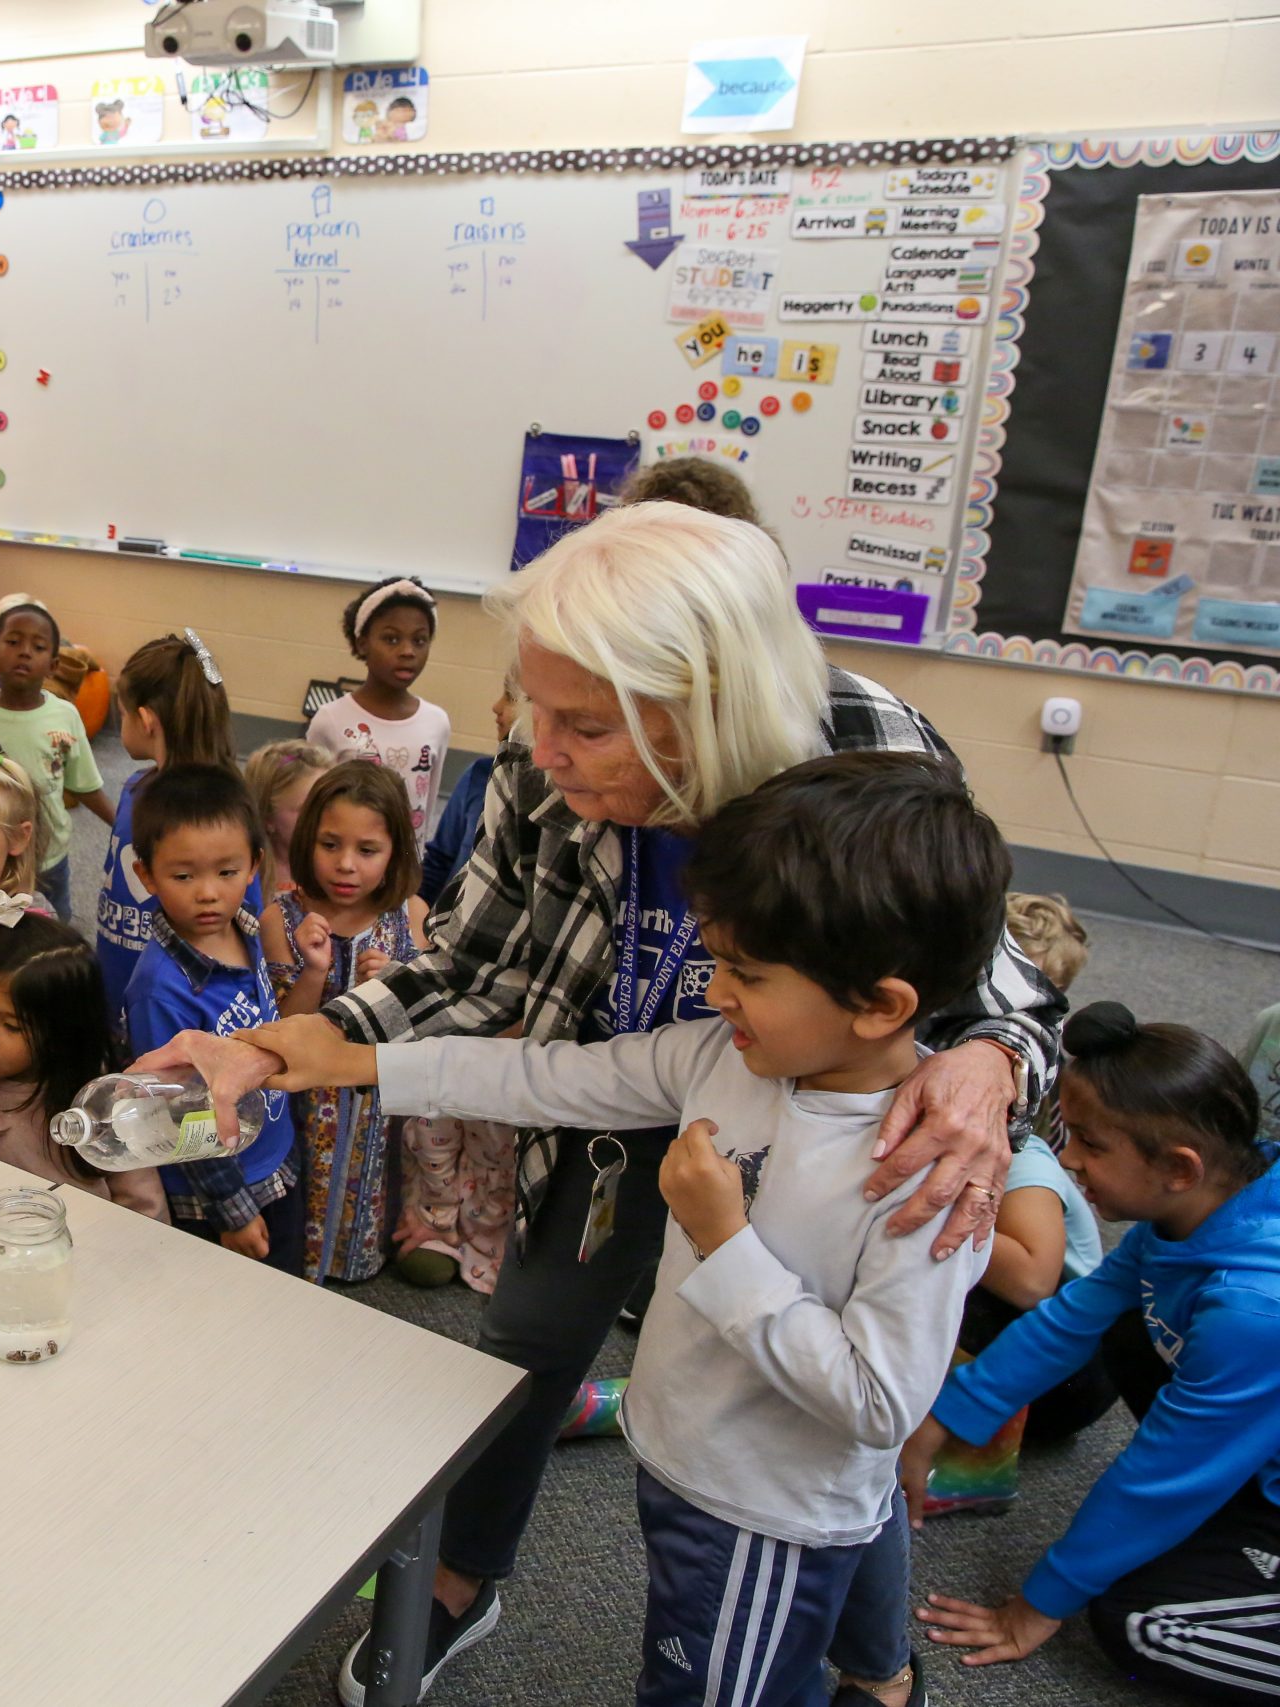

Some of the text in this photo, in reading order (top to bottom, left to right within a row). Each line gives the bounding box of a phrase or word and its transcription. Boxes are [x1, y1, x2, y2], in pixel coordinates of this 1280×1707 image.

[718, 80, 788, 96] because
[701, 170, 779, 186] TODAY'S DATE
[909, 183, 971, 195] Schedule
[902, 206, 960, 219] Morning
[453, 222, 526, 242] raisins
[797, 216, 856, 230] Arrival
[901, 219, 957, 233] Meeting
[1200, 215, 1271, 235] TODAY IS
[111, 228, 193, 250] cranberries
[286, 221, 360, 251] popcorn
[294, 249, 338, 267] kernel
[891, 247, 969, 261] Calendar
[675, 266, 773, 291] STUDENT
[885, 267, 958, 280] Language
[885, 281, 915, 293] Arts
[783, 299, 853, 314] Heggerty
[872, 329, 928, 348] Lunch
[737, 347, 763, 363] he
[797, 353, 821, 372] is
[1243, 347, 1257, 364] 4
[878, 368, 922, 382] Aloud
[864, 389, 938, 412] Library
[863, 420, 922, 437] Snack
[852, 450, 922, 473] Writing
[853, 478, 917, 496] Recess
[818, 496, 867, 519] STEM
[849, 538, 921, 562] Dismissal
[619, 901, 674, 935] rth
[622, 870, 640, 973] ELEMENTARY
[636, 909, 699, 1032] ORTHPOINT ELEM
[620, 973, 633, 1031] SCHOOL
[657, 1643, 692, 1672] adidas
